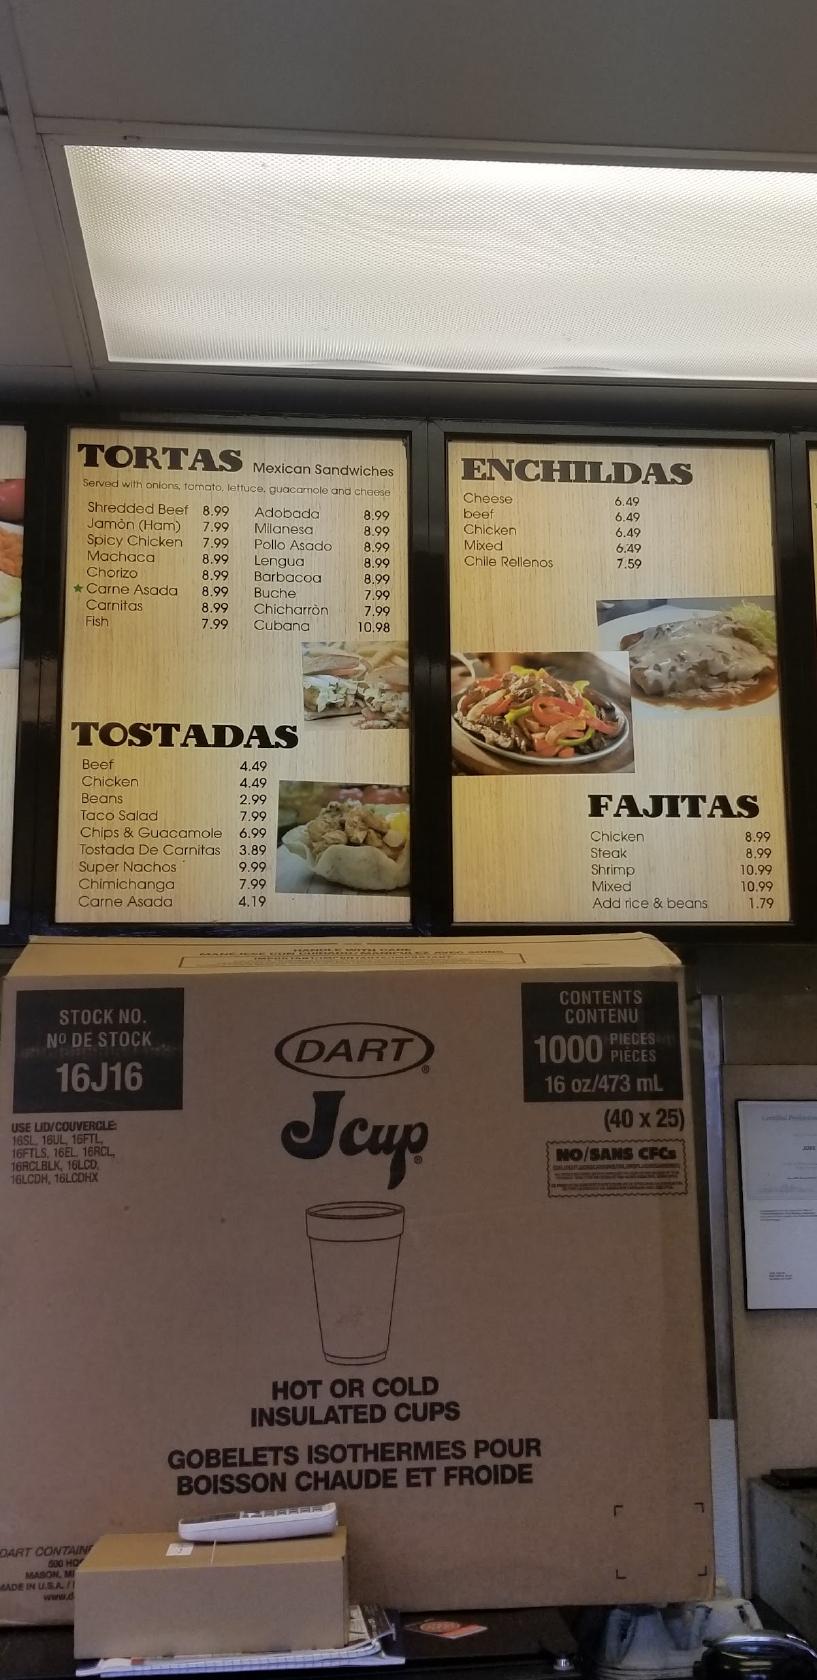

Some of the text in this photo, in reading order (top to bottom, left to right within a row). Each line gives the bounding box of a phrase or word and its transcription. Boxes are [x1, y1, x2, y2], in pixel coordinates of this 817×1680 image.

[78, 444, 242, 472] TORTAS
[253, 463, 394, 477] Mexican Sandwiches
[461, 458, 693, 486] ENCHILDAS
[83, 479, 118, 488] Served
[146, 482, 180, 490] onions,
[184, 483, 224, 492] tomato,
[227, 483, 266, 493] lettuce,
[270, 486, 328, 495] guacamole
[331, 487, 351, 495] and
[354, 488, 391, 496] cheese
[464, 493, 640, 507] Cheese 6.49
[88, 502, 229, 516] Shredded Beef 8.99
[254, 507, 389, 521] Adobada 8.99
[464, 508, 640, 522] beef 6.49
[139, 520, 181, 533] (Ham)
[203, 522, 229, 533] 7.99
[254, 523, 390, 537] Milanesa 8.99
[464, 524, 641, 538] Chicken 6.49
[88, 534, 229, 549] Spicy Chicken 7.99
[254, 539, 390, 552] Pollo Asado 8.99
[464, 540, 641, 554] Mixed 6.49
[88, 550, 229, 564] Machaca 8.99
[254, 555, 390, 569] Lengua 8.99
[464, 556, 642, 569] Chile Rellenos 7.59
[87, 567, 229, 580] Chorizo 8.99
[254, 571, 390, 584] Barbacoa 8.99
[86, 583, 229, 597] Carne Asada 8.99
[254, 587, 390, 600] Buche 7.99
[86, 599, 228, 613] Carnitas 8.99
[364, 606, 390, 617] 7.99
[86, 616, 228, 629] Fish 7.99
[254, 620, 390, 633] Cubana 10.98
[71, 722, 299, 749] TOSTADAS
[83, 759, 267, 772] Beef 4.49
[82, 775, 267, 788] Chicken 4.49
[81, 793, 267, 805] Beans 2.99
[588, 795, 759, 818] FAJITAS
[81, 810, 267, 822] Taco Salad 7.99
[80, 827, 267, 840] Chips & Guacamole 6.99
[591, 831, 771, 842] Chicken 8.99
[80, 844, 266, 856] Tostada De Carnitas 3.89
[591, 848, 772, 859] Steak 8.99
[79, 861, 266, 874] Super Nachos 9.99
[591, 864, 772, 877] Shrimp 10.99
[79, 879, 266, 893] Chimichanga 7.99
[592, 881, 773, 892] Mixed 10.99
[78, 896, 266, 907] Carne Asada 4.19
[592, 898, 774, 909] Add rice & beans 1.79
[560, 990, 642, 1005] CONTENTS
[60, 1009, 146, 1025] STOCK NO.
[565, 1008, 638, 1024] CONTENU
[72, 1033, 92, 1047] DE
[98, 1031, 151, 1047] STOCK
[610, 1032, 656, 1045] PIECES
[295, 1038, 414, 1063] DART
[534, 1035, 603, 1063] 1000
[56, 1062, 143, 1092] 16J16
[545, 1074, 664, 1093] 16 oz/473 mL
[604, 1108, 684, 1131] (40 x 25)
[12, 1123, 31, 1133] USE
[556, 1146, 676, 1162] NO/SANS CFCs
[272, 1376, 439, 1400] HOT OR COLD
[251, 1401, 460, 1427] INSULATED CUPS
[168, 1438, 541, 1469] GOBELETS ISOTHERMES POUR
[177, 1463, 533, 1495] BOISSON CHAUDE ET FROIDE
